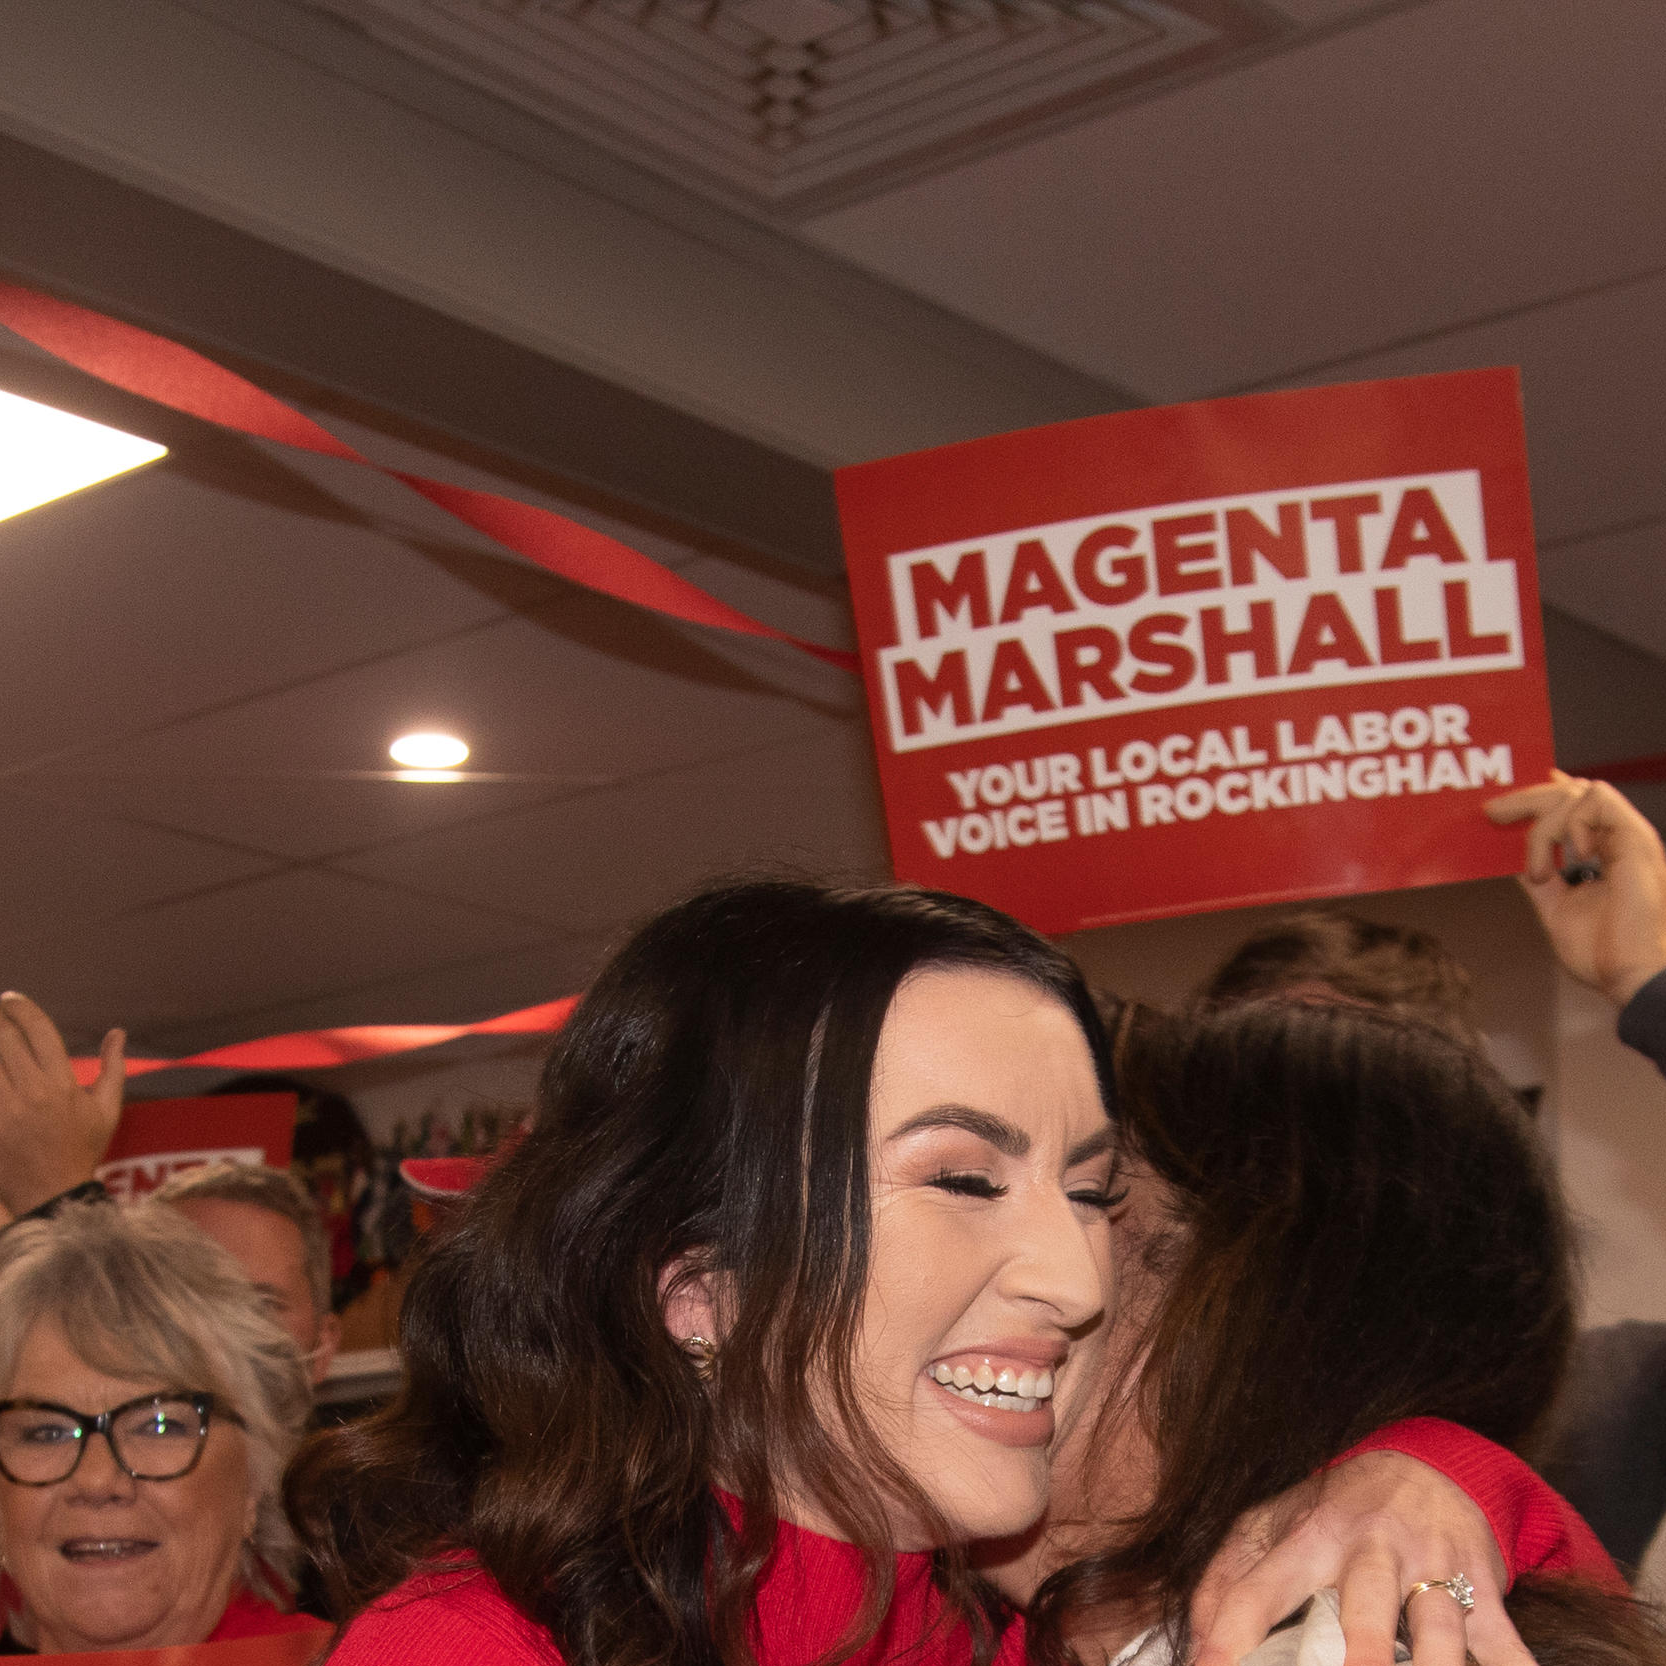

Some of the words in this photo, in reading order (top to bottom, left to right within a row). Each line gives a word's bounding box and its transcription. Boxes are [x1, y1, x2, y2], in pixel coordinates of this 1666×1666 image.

[909, 487, 1466, 640] MAGENTA
[891, 578, 1512, 738] MARSHALL
[922, 801, 1070, 860] VOICE
[1077, 791, 1131, 838] IN
[1140, 745, 1513, 828] ROCKINGHAM
[947, 751, 1082, 810] YOUR
[1091, 726, 1267, 787] LOCAL
[1278, 704, 1471, 760] LABOR
